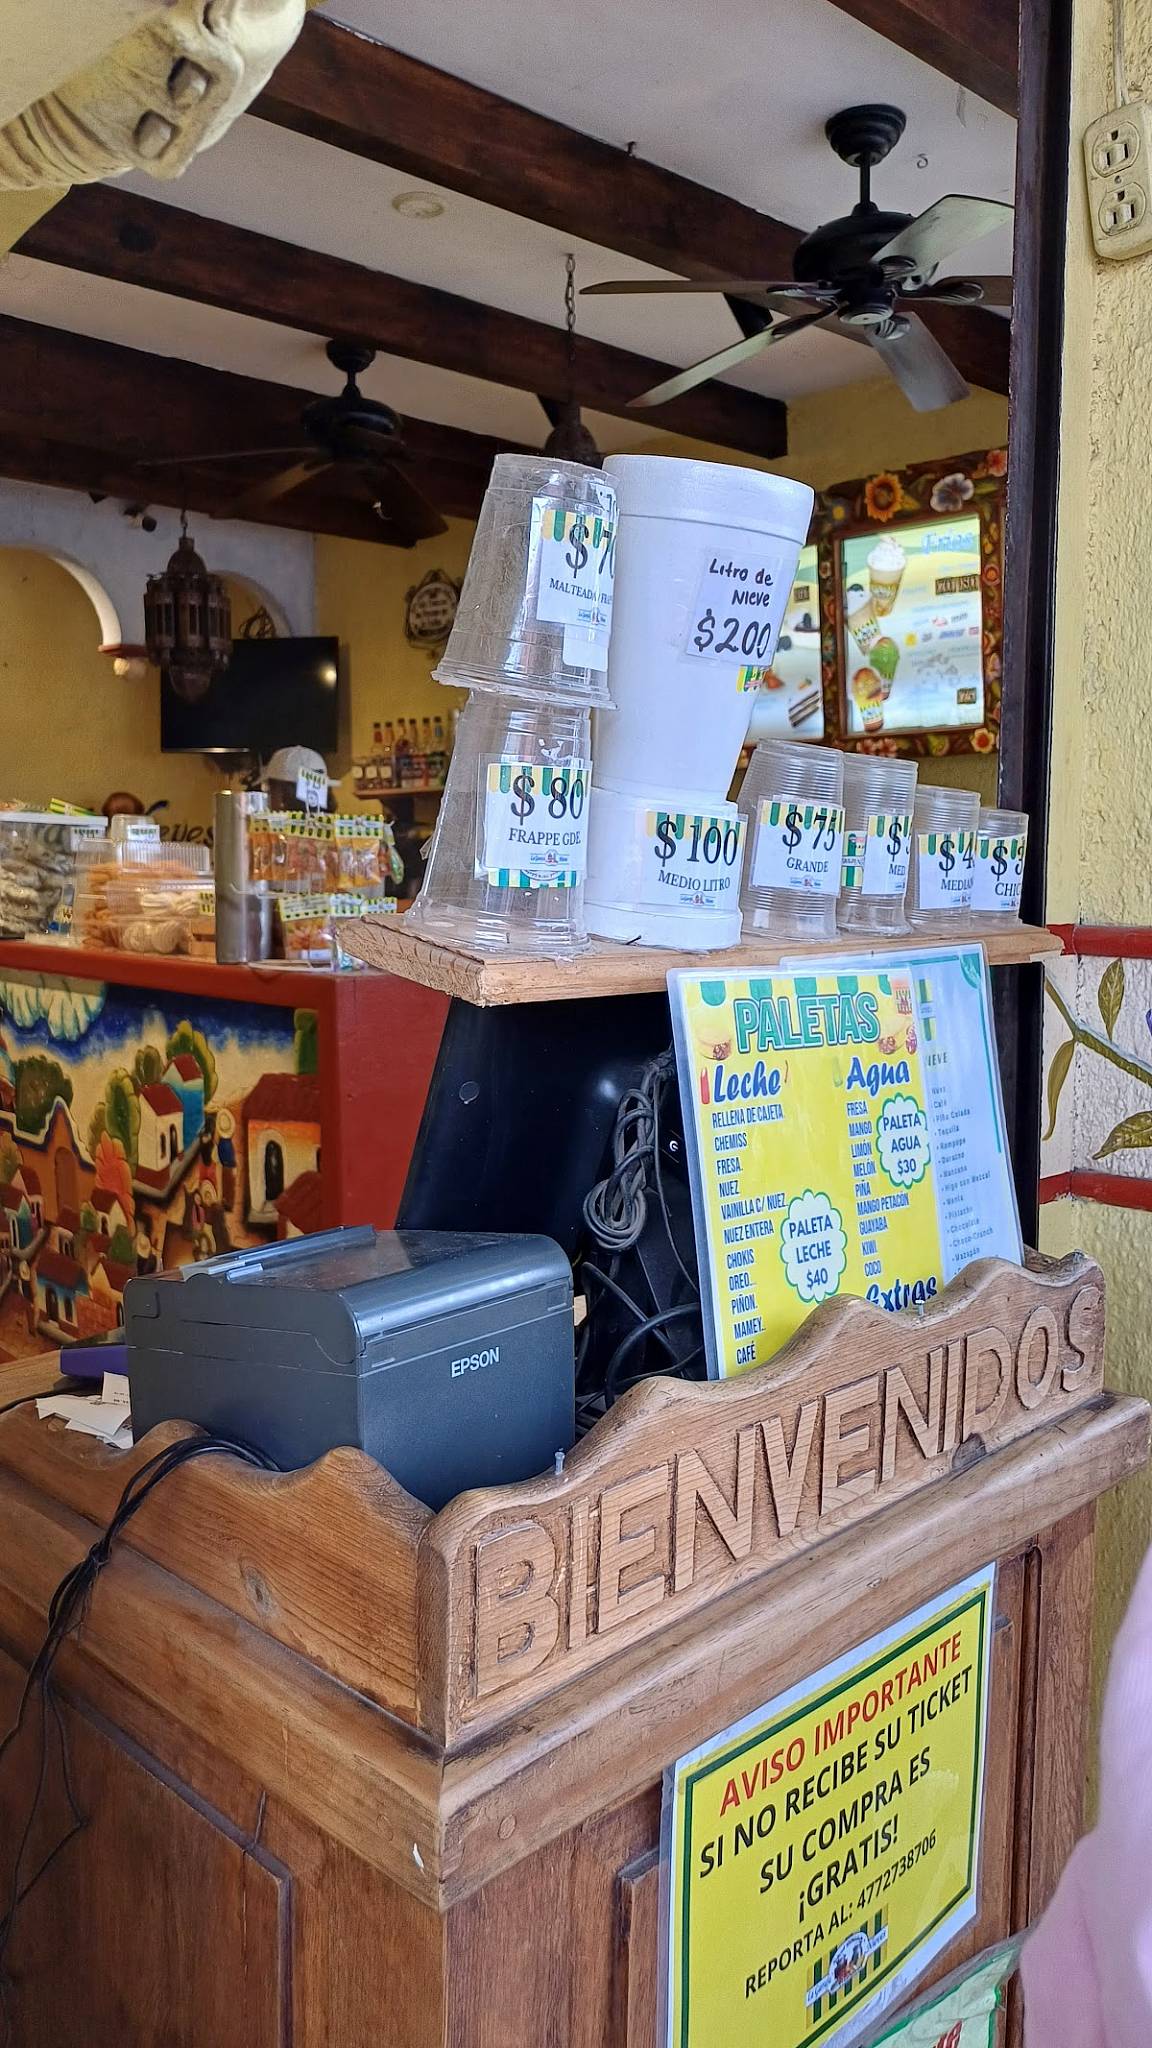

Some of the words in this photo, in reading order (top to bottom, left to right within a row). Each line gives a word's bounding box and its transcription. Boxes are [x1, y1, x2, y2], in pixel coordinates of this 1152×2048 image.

[709, 558, 748, 581] Litro
[755, 568, 773, 586] de
[694, 608, 771, 659] $200
[509, 827, 560, 846] FRAPPE
[562, 831, 581, 846] GDE
[963, 837, 975, 869] 4
[787, 856, 829, 873] GRANDE
[658, 870, 700, 891] MEDIO
[703, 877, 731, 891] LITRO
[733, 991, 881, 1053] PALETAS
[926, 1052, 949, 1067] IEVE
[714, 1061, 781, 1103] Leche
[846, 1057, 910, 1096] Agua
[712, 1108, 745, 1128] RELLENA
[747, 1107, 756, 1123] DE
[757, 1104, 784, 1121] CAJETA
[847, 1101, 868, 1116] FRESA
[849, 1121, 872, 1136] MANGO
[882, 1113, 922, 1131] PALETA
[715, 1133, 747, 1151] CHEMISS
[851, 1139, 872, 1158] LIMÓN
[891, 1135, 921, 1153] AGUA
[853, 1159, 876, 1177] MELÓN
[898, 1158, 917, 1176] $30
[719, 1180, 739, 1197] NUEZ
[855, 1180, 871, 1197] PIÑA
[721, 1199, 754, 1220] VAINILLA
[857, 1198, 880, 1215] MANGO
[724, 1226, 744, 1244] NUEZ
[745, 1219, 774, 1238] ENTERA
[789, 1215, 833, 1238] PALETA
[859, 1216, 888, 1235] GUAYABA
[727, 1249, 754, 1269] CHOKIS
[796, 1240, 832, 1264] LECHE
[862, 1240, 877, 1256] KIWI
[807, 1267, 828, 1290] $40
[864, 1260, 882, 1277] COCO
[866, 1277, 938, 1312] Extras
[451, 1346, 500, 1378] EPSON
[737, 1340, 756, 1364] CAFÉ
[476, 1286, 1101, 1700] BIENVENIDOS
[720, 1737, 806, 1818] AVISO
[814, 1630, 961, 1757] IMPORTANTE
[700, 1834, 723, 1878] SI
[734, 1803, 776, 1857] NO
[785, 1740, 868, 1822] RECIBE
[874, 1716, 901, 1760] SU
[907, 1664, 973, 1735] TICKET
[760, 1844, 793, 1894] SU
[802, 1769, 903, 1862] COMPRA
[909, 1746, 930, 1786] ES
[799, 1813, 898, 1923] ¡GRATIS!
[746, 1922, 824, 1998] REPORTA
[828, 1902, 853, 1936] AL:
[856, 1828, 936, 1911] 4772738706
